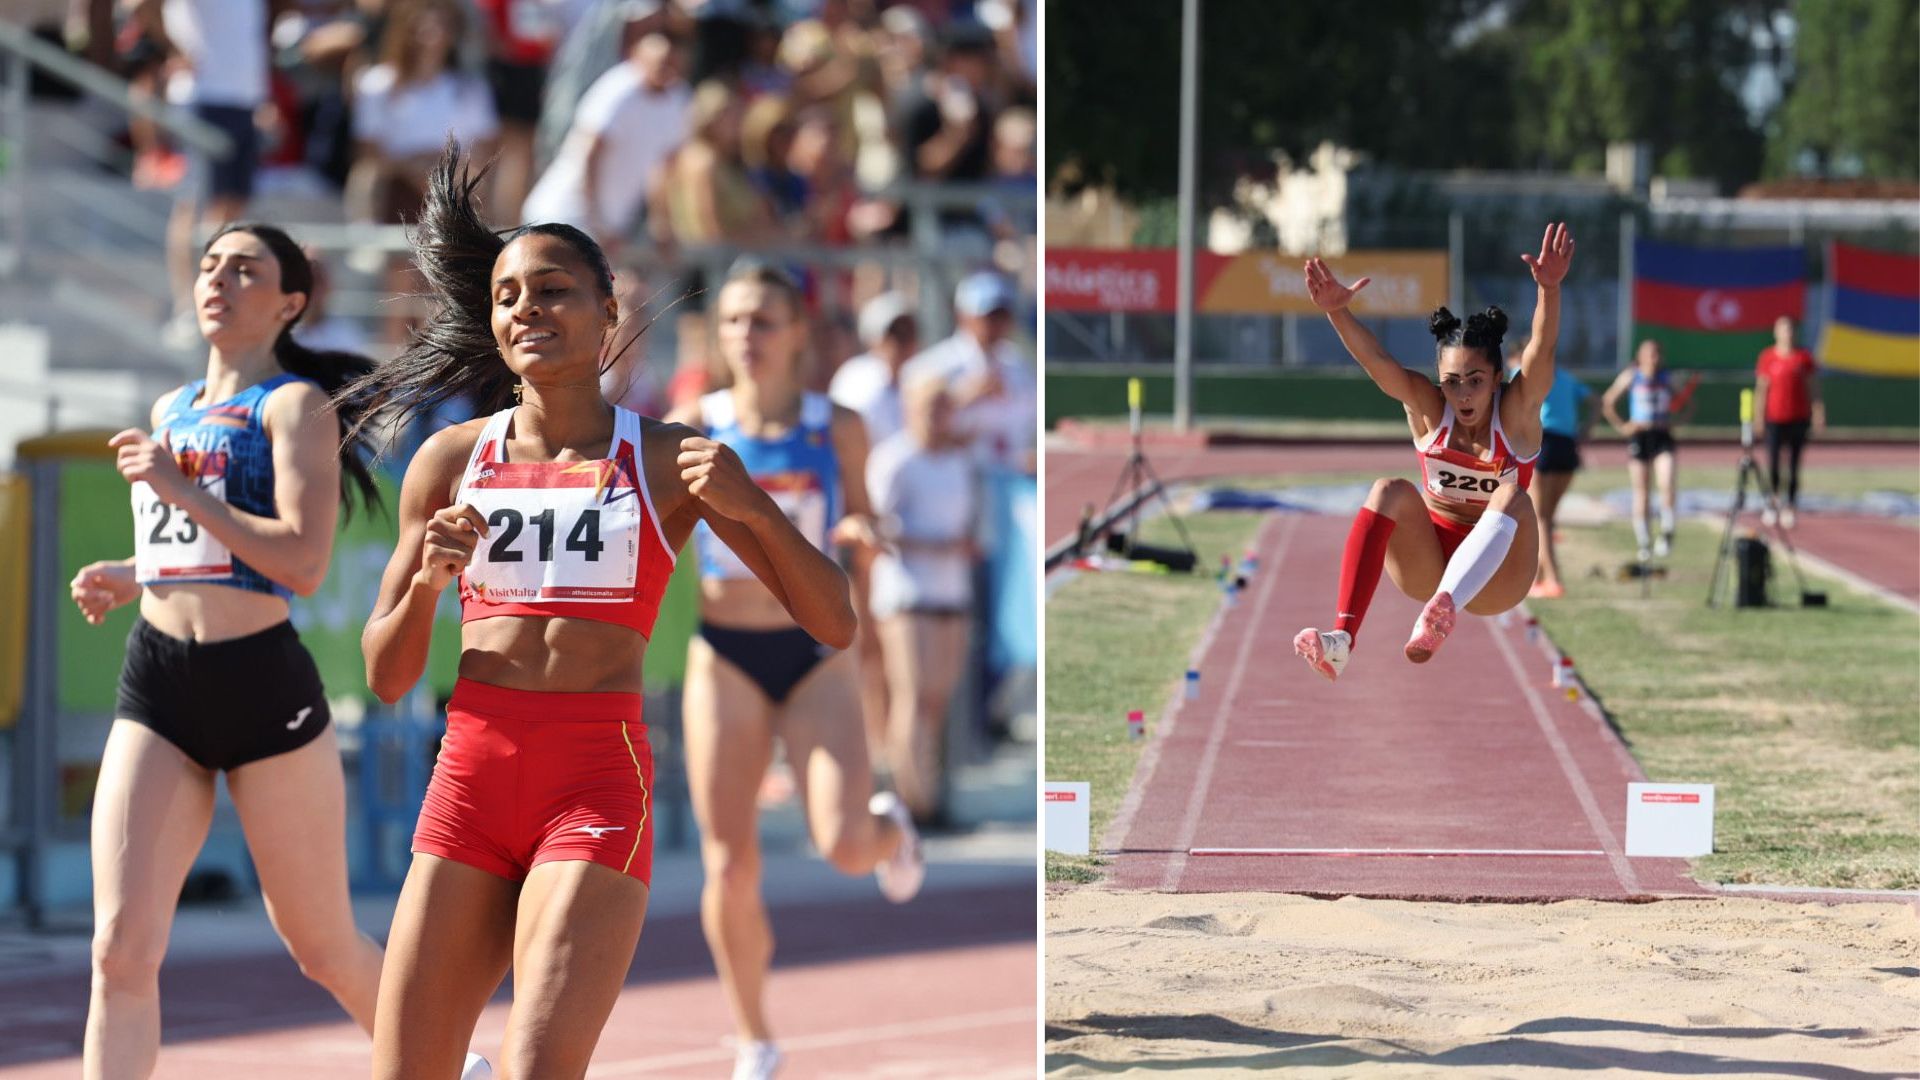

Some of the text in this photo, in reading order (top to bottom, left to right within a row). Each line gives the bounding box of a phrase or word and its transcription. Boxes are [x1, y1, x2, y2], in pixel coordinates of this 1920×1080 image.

[1438, 470, 1500, 493] 220
[487, 508, 604, 563] 214
[488, 588, 537, 597] VisitMalta
